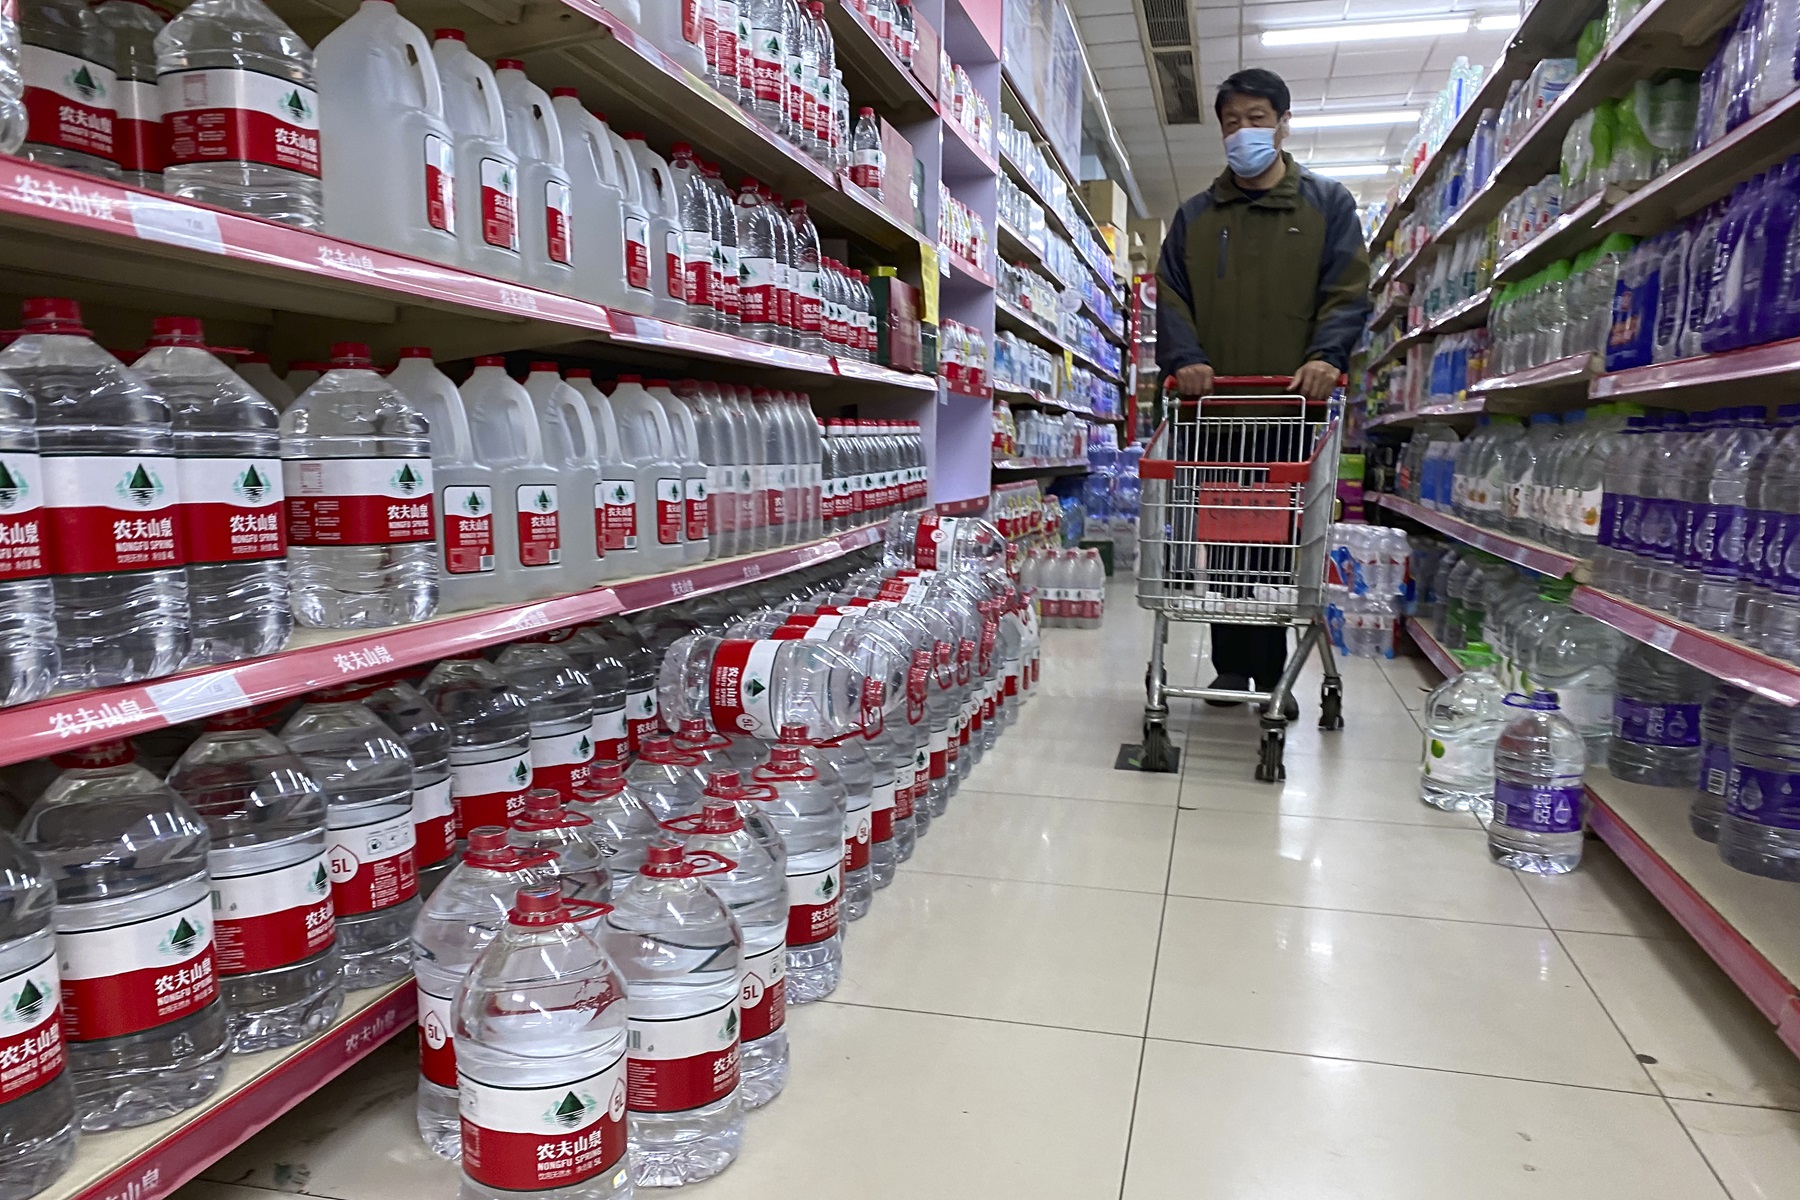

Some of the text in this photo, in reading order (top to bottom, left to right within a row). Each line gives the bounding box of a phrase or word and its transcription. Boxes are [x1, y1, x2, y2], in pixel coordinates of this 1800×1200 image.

[230, 514, 278, 532] 农夫山泉
[387, 504, 428, 520] 农夫山泉
[113, 517, 173, 540] 农夫山泉
[333, 645, 395, 674] 农夫山泉
[48, 698, 146, 738] 农夫山泉
[332, 858, 351, 874] 5L
[155, 957, 212, 995] 农夫山泉
[157, 987, 191, 1007] NONGFU
[743, 985, 758, 1000] 5L
[345, 1010, 396, 1053] 农夫山泉
[428, 1024, 441, 1042] 5L
[0, 1022, 60, 1070] 农夫山泉
[1, 1057, 38, 1082] NONGFU
[536, 1129, 602, 1161] 农夫山泉
[537, 1147, 602, 1171] NONGFU SPRING
